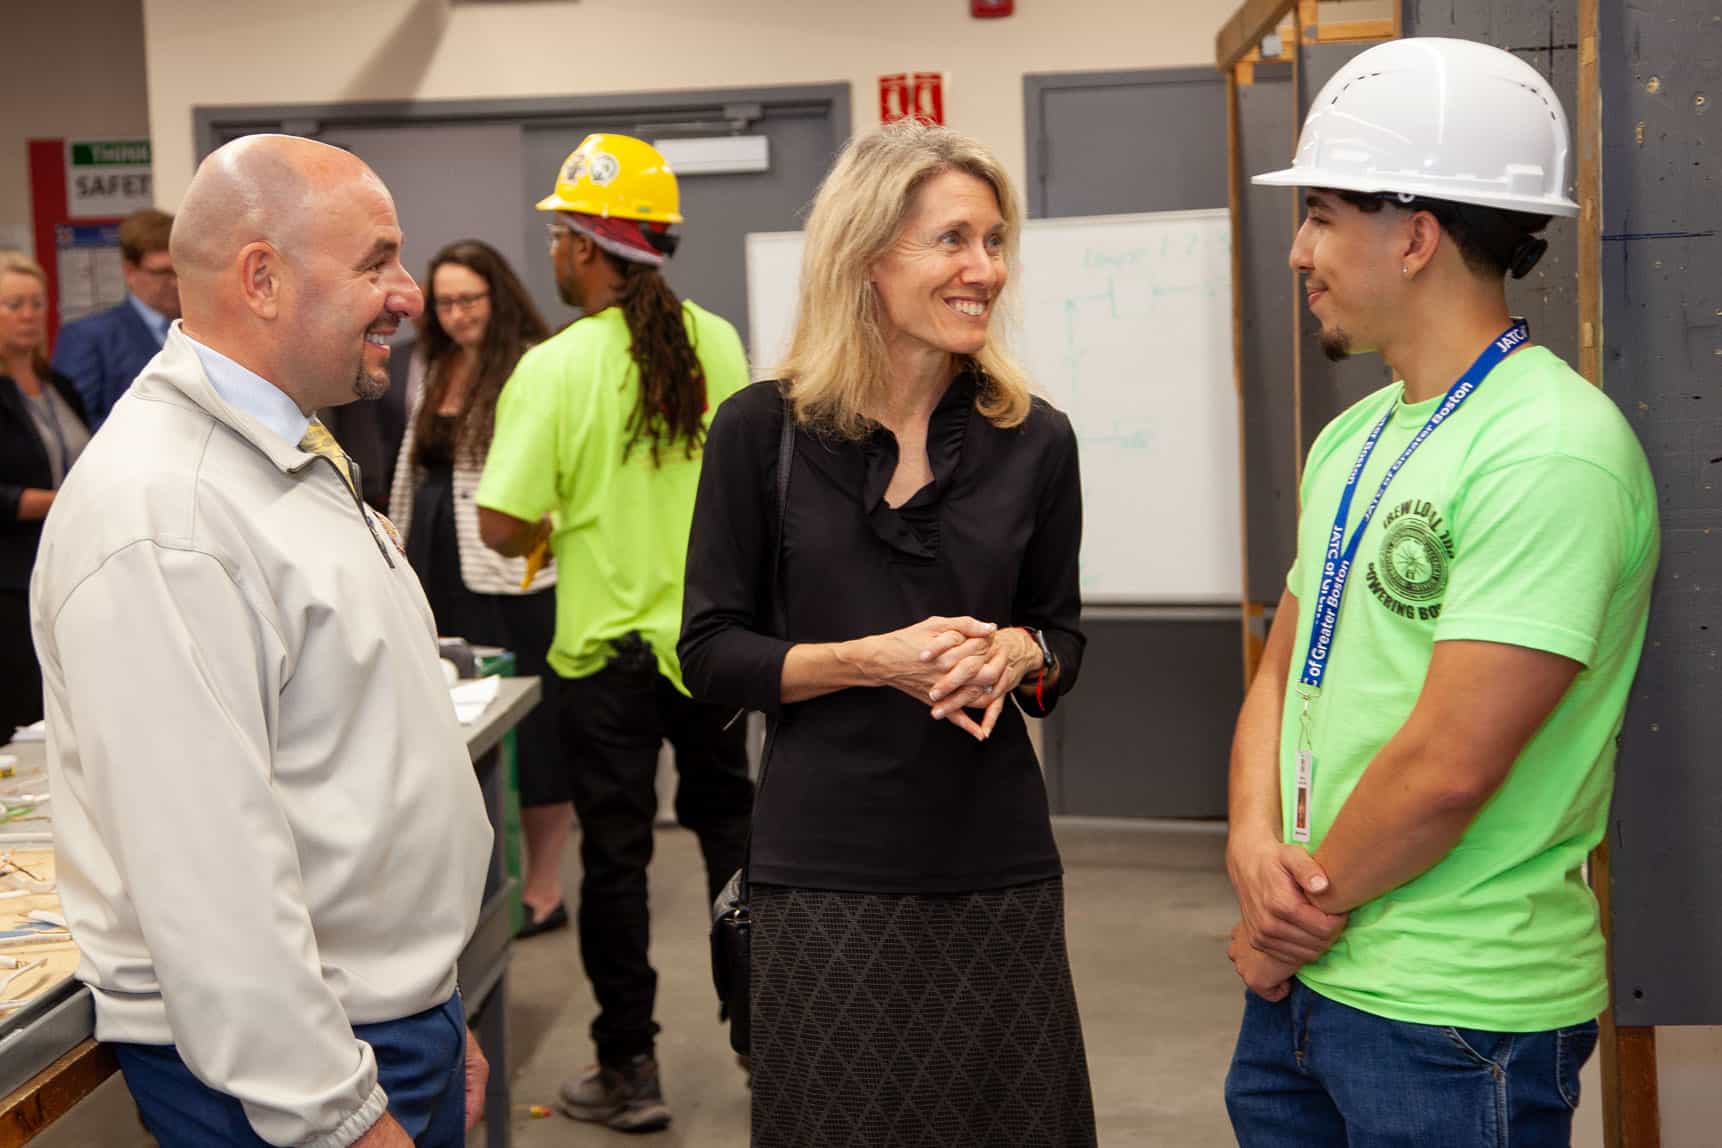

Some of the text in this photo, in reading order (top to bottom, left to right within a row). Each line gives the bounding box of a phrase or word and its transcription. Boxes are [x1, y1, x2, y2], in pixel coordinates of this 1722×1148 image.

[1496, 328, 1524, 353] JATC
[1431, 381, 1474, 424] Boston
[1328, 526, 1344, 559] JATC
[1327, 560, 1350, 609] Boston
[1312, 608, 1336, 660] Greater
[1309, 658, 1321, 678] of
